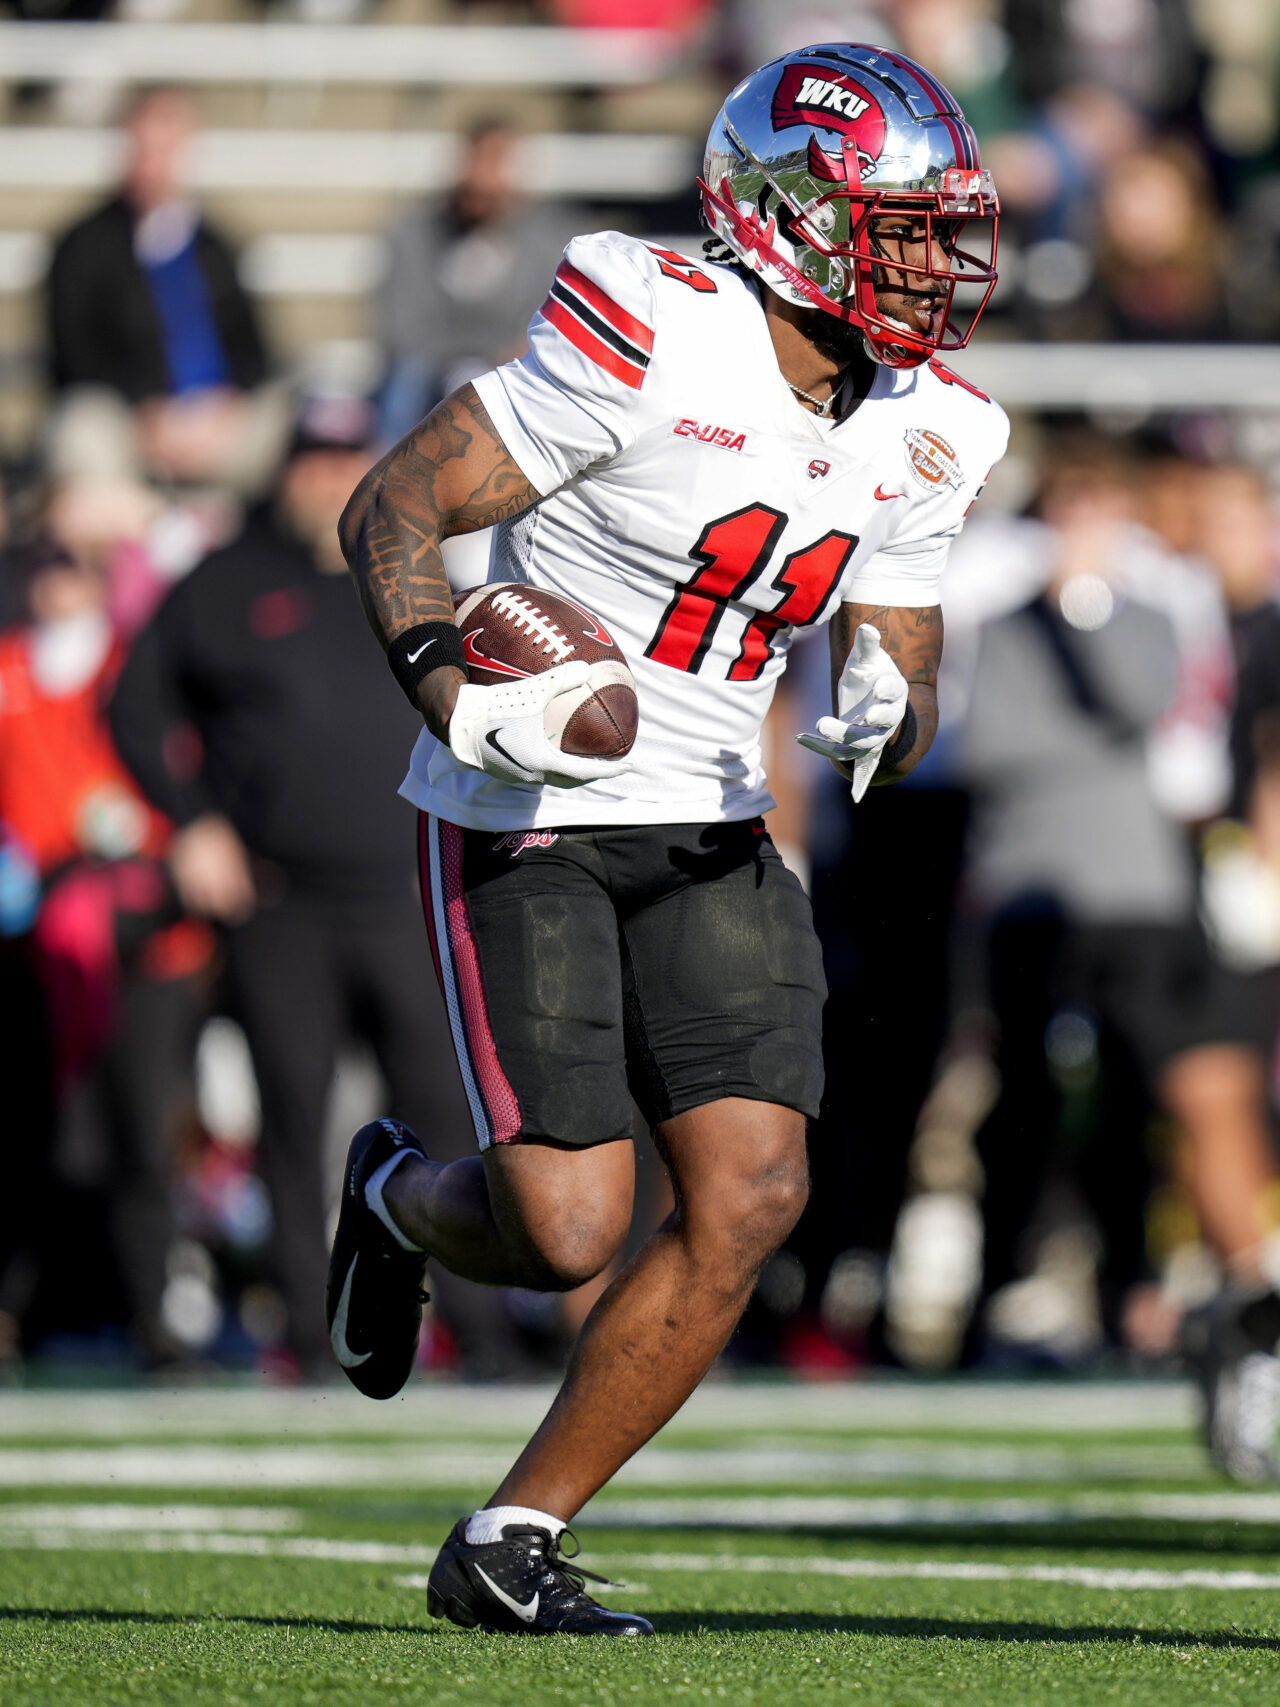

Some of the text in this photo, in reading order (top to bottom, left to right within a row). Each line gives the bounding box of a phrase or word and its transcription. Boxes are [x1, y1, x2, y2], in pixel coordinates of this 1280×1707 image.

[794, 76, 872, 120] WKU
[642, 500, 860, 681] 11
[491, 829, 559, 857] Tops
